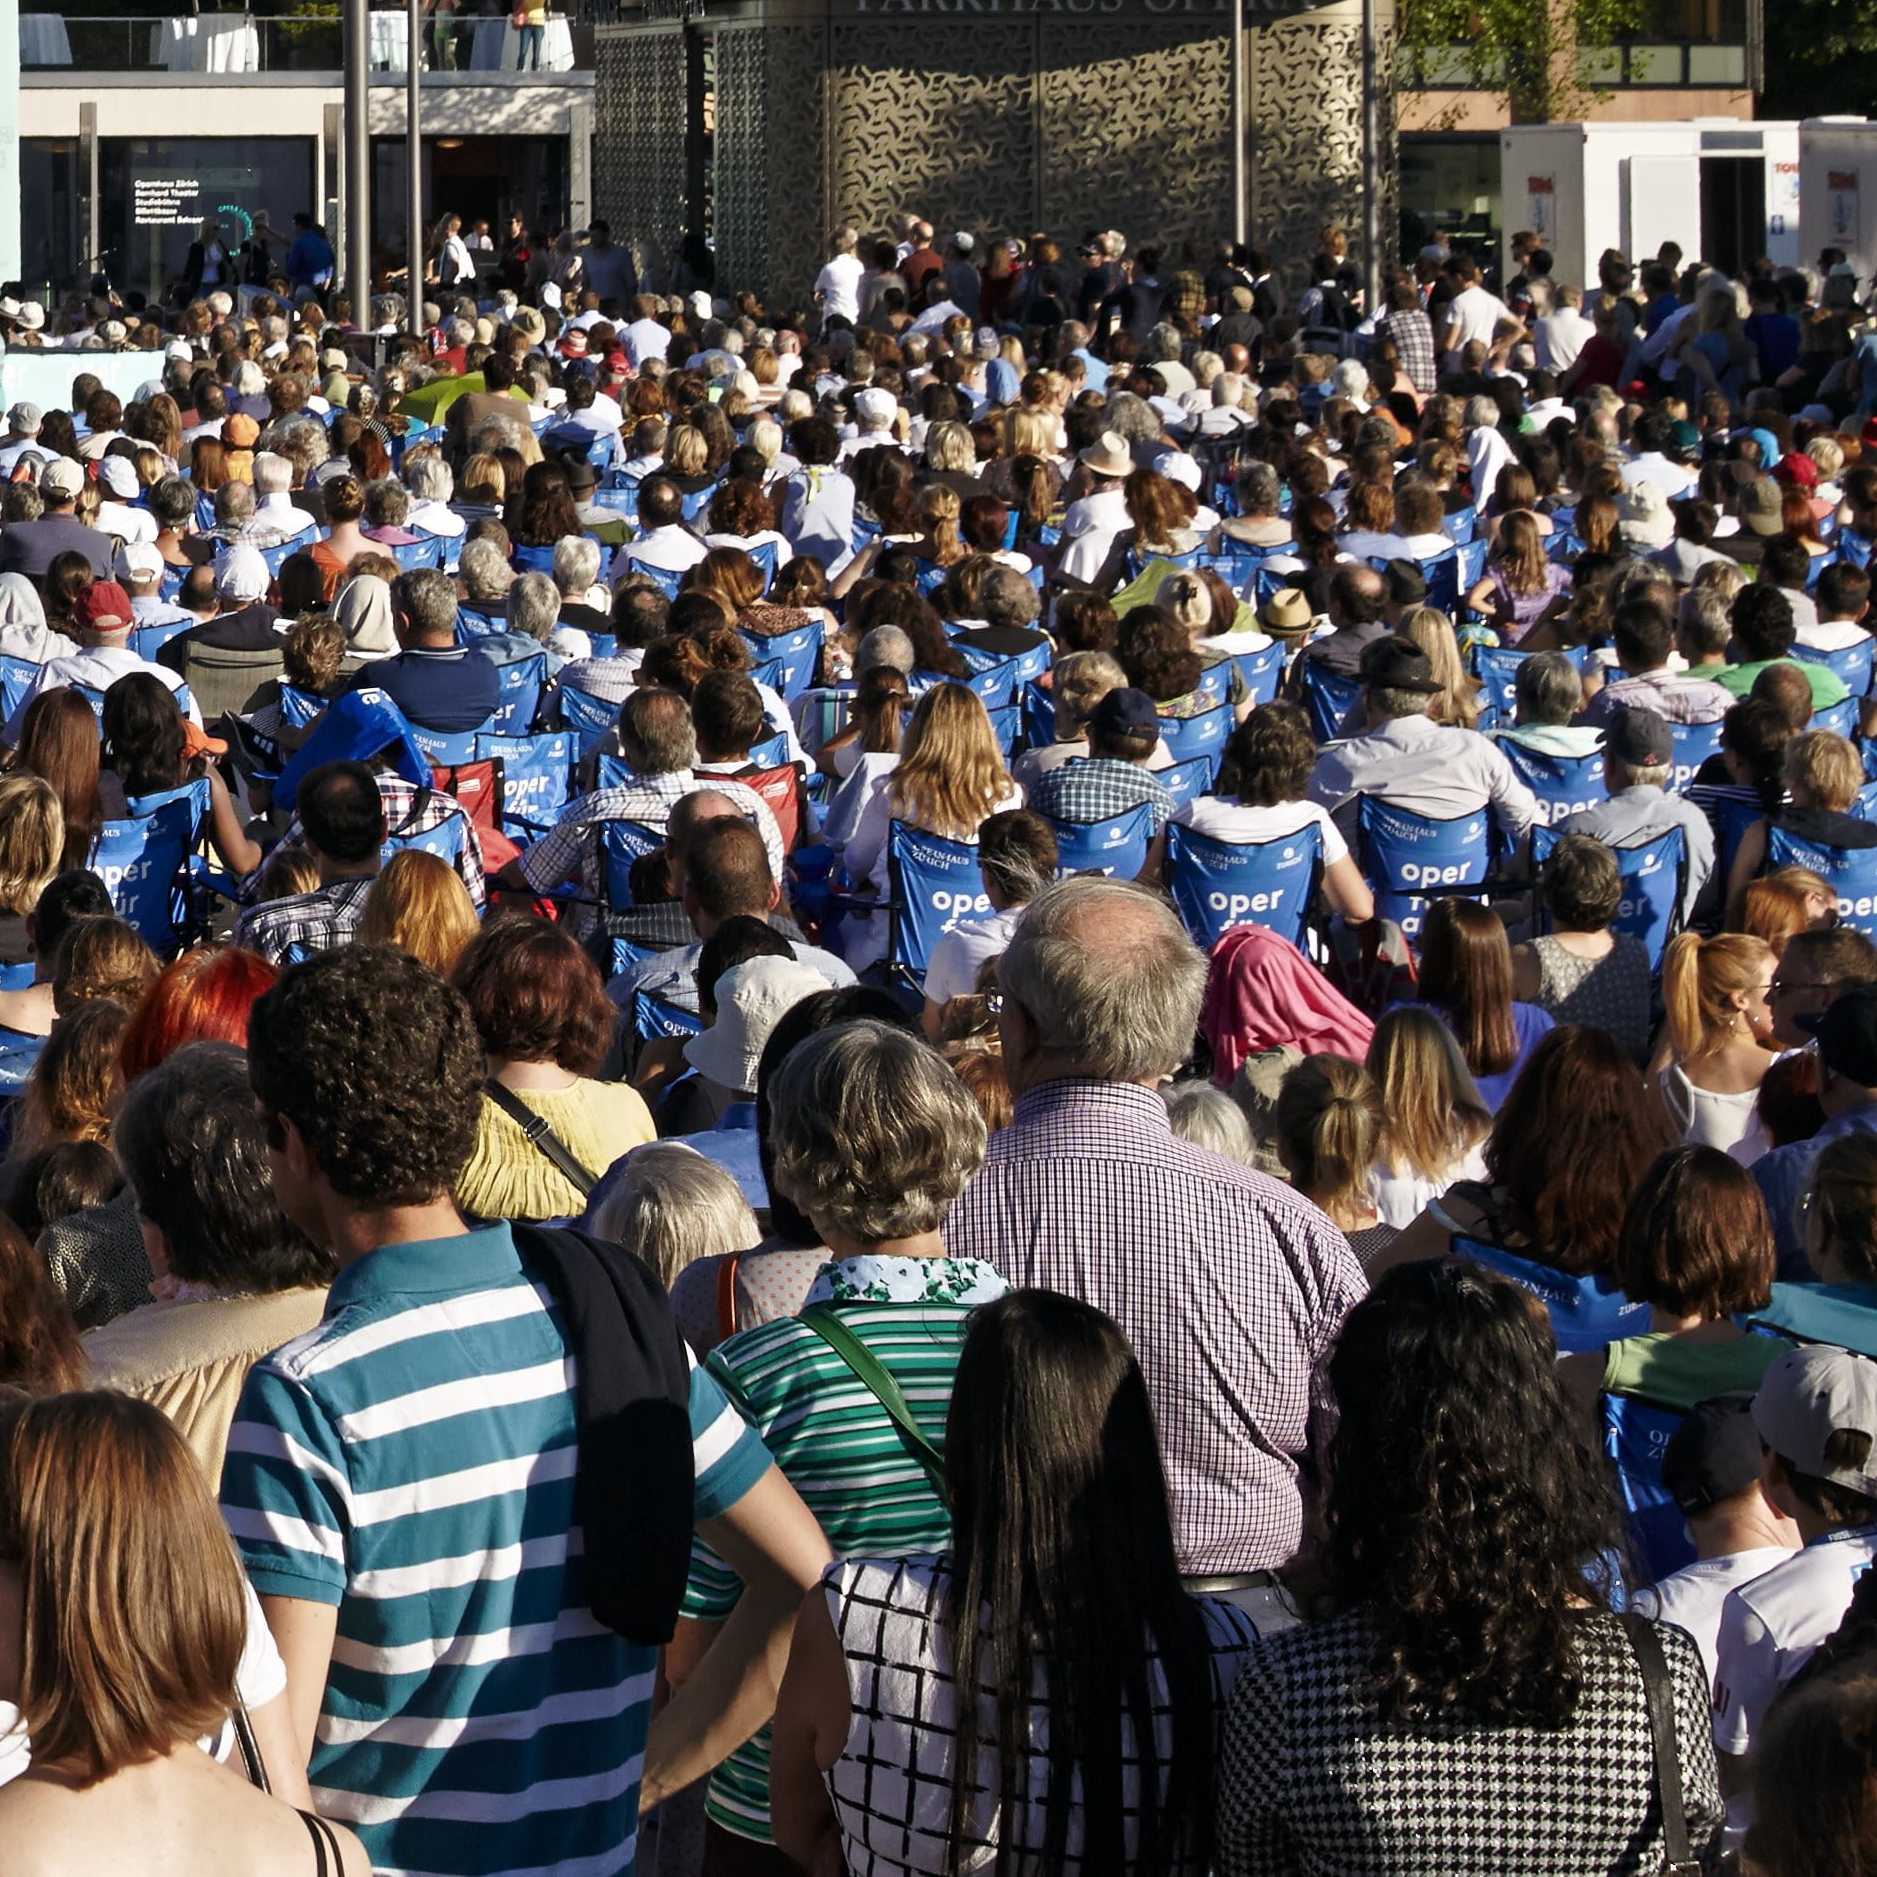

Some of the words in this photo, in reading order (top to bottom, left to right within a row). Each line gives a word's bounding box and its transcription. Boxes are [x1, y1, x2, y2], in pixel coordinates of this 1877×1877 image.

[504, 775, 550, 802] oper
[1401, 861, 1472, 889] oper
[931, 890, 991, 919] ope
[1207, 889, 1284, 921] oper
